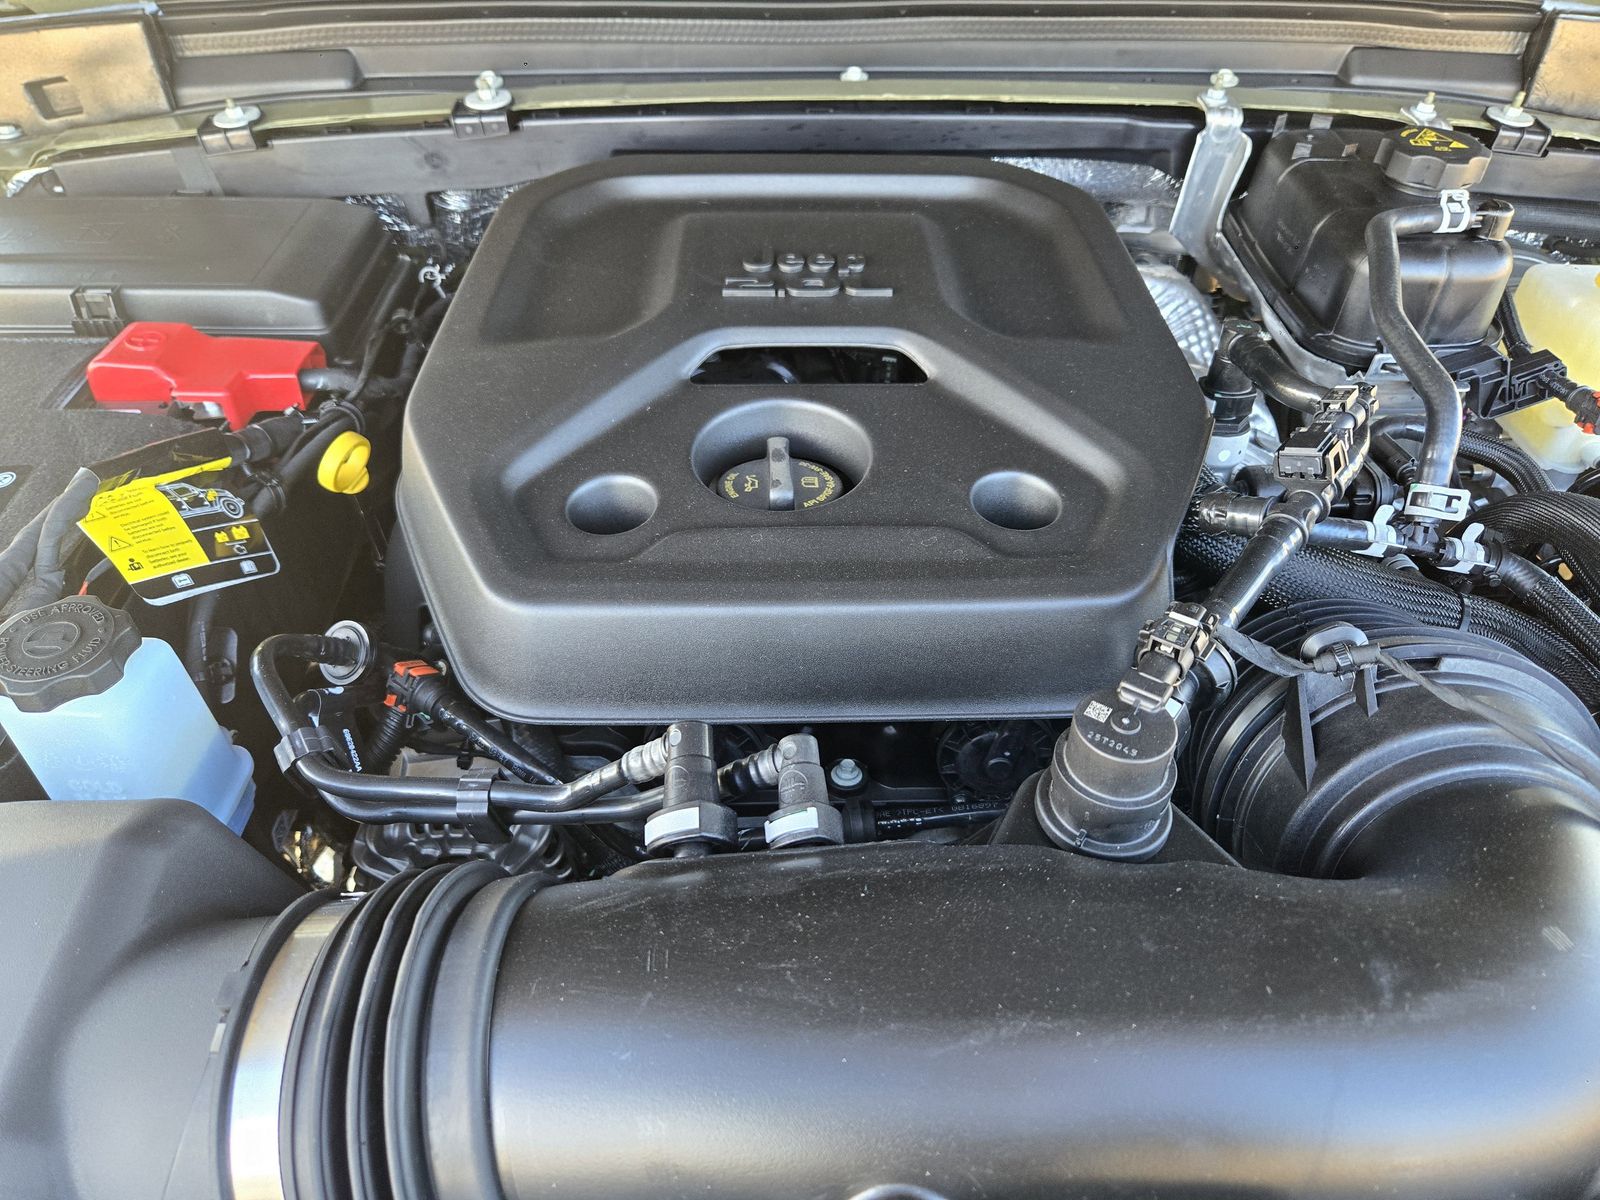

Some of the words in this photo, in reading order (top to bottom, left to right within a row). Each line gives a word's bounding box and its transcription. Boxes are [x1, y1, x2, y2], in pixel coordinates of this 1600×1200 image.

[743, 251, 865, 277] Jeep
[722, 277, 893, 297] 2.0L
[803, 499, 820, 508] API
[21, 609, 46, 624] USE
[48, 602, 105, 623] APPROVED
[7, 659, 69, 677] STEERING
[71, 636, 101, 663] FLUID
